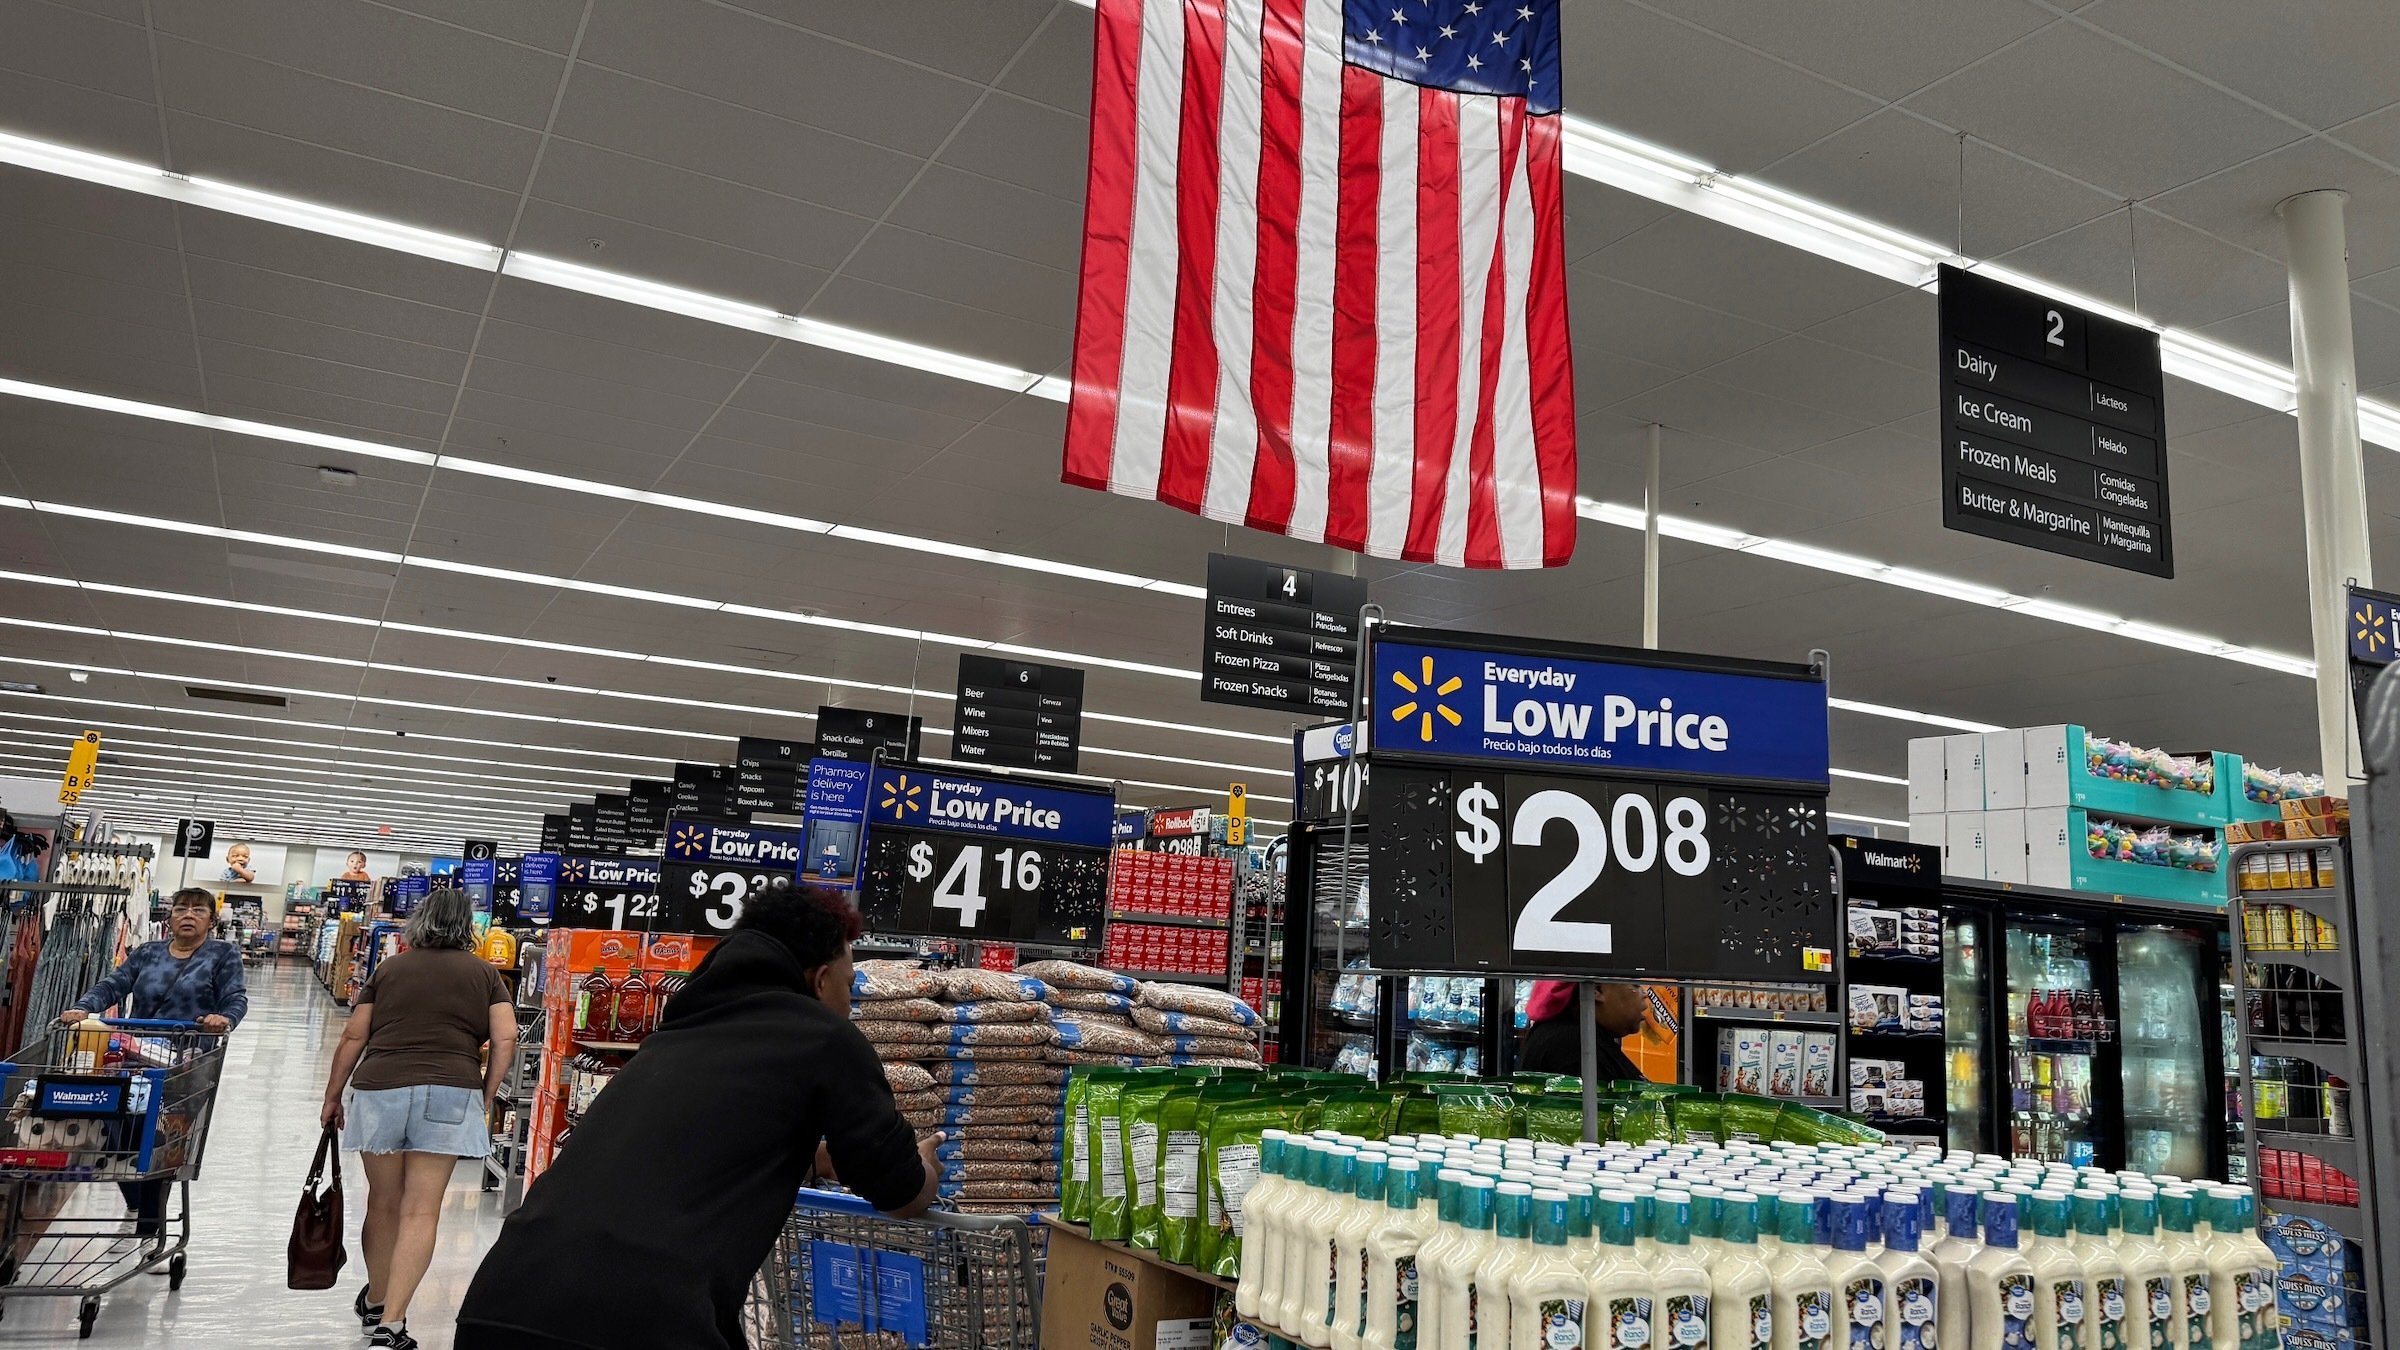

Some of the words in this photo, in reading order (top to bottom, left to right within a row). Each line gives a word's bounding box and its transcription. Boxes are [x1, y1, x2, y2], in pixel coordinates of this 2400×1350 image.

[2047, 310, 2065, 347] 2
[1958, 349, 1998, 382] Dairy
[2096, 392, 2128, 412] Lácteos
[1958, 395, 1980, 419] Ice
[1984, 403, 2032, 433] Cream
[2098, 436, 2128, 455] Helado
[1959, 440, 2010, 472] Frozen
[2015, 455, 2057, 484] Meals
[2100, 472, 2136, 493] Comidas
[2101, 487, 2149, 511] Congeladas
[1962, 487, 2005, 515] Butter
[2009, 499, 2020, 518] &
[2023, 503, 2091, 536] Margarine
[2103, 517, 2151, 539] Mantequilla
[2104, 533, 2110, 545] y
[2111, 533, 2152, 554] Margarina
[1283, 575, 1297, 597] 4
[1217, 600, 1256, 618] Entrees
[1316, 613, 1334, 623] Platos
[1316, 621, 1347, 633] Principales
[1216, 626, 1238, 641] Soft
[1240, 629, 1274, 646] Drinks
[1315, 642, 1344, 653] Refrescos
[1215, 652, 1250, 668] Frozen
[1253, 657, 1280, 672] Pizza
[1020, 671, 1029, 683] 6
[1484, 661, 1577, 693] Everyday
[965, 688, 985, 699] Beer
[1214, 678, 1249, 694] Frozen
[1252, 683, 1288, 698] Snacks
[964, 707, 986, 718] Wine
[1484, 684, 1593, 740] Low
[1604, 694, 1729, 752] Price
[866, 718, 874, 729] 8
[962, 725, 990, 738] Mixers
[822, 733, 843, 744] Snack
[844, 735, 864, 745] Cakes
[780, 746, 791, 756] 10
[822, 748, 848, 759] Tortillas
[961, 744, 986, 756] Water
[1484, 738, 1516, 752] Precio
[1518, 741, 1541, 755] bajo
[1543, 743, 1573, 757] todos
[1575, 746, 1590, 758] los
[1591, 746, 1612, 759] días
[742, 759, 760, 768] Chips
[712, 770, 722, 779] 12
[741, 772, 762, 781] Snacks
[814, 764, 866, 781] Pharmacy
[68, 776, 79, 787] B
[678, 782, 697, 791] Candy
[812, 777, 854, 793] delivery
[933, 779, 983, 796] Everyday
[61, 791, 78, 802] 25
[739, 785, 765, 794] Popcorn
[811, 790, 820, 801] is
[822, 791, 845, 803] here
[678, 793, 699, 801] Cookies
[738, 798, 758, 807] Boxed
[758, 799, 774, 808] Juice
[676, 804, 699, 812] Crackers
[930, 792, 990, 822] Low
[994, 797, 1061, 830] Price
[929, 817, 947, 826] Precio
[947, 819, 960, 828] bajo
[961, 821, 977, 830] todos
[1231, 818, 1241, 828] D
[713, 828, 751, 841] Everyday
[1233, 832, 1239, 842] 5
[710, 836, 756, 857] Low
[758, 840, 800, 861] Pric
[590, 860, 620, 869] Everyday
[1865, 852, 1908, 870] Walmart
[589, 865, 624, 882] Low
[53, 1091, 95, 1102] Walmart
[1108, 1290, 1129, 1314] Great
[1111, 1307, 1128, 1323] Value
[1090, 1323, 1109, 1341] GARLIC
[1110, 1330, 1131, 1350] PEPPER
